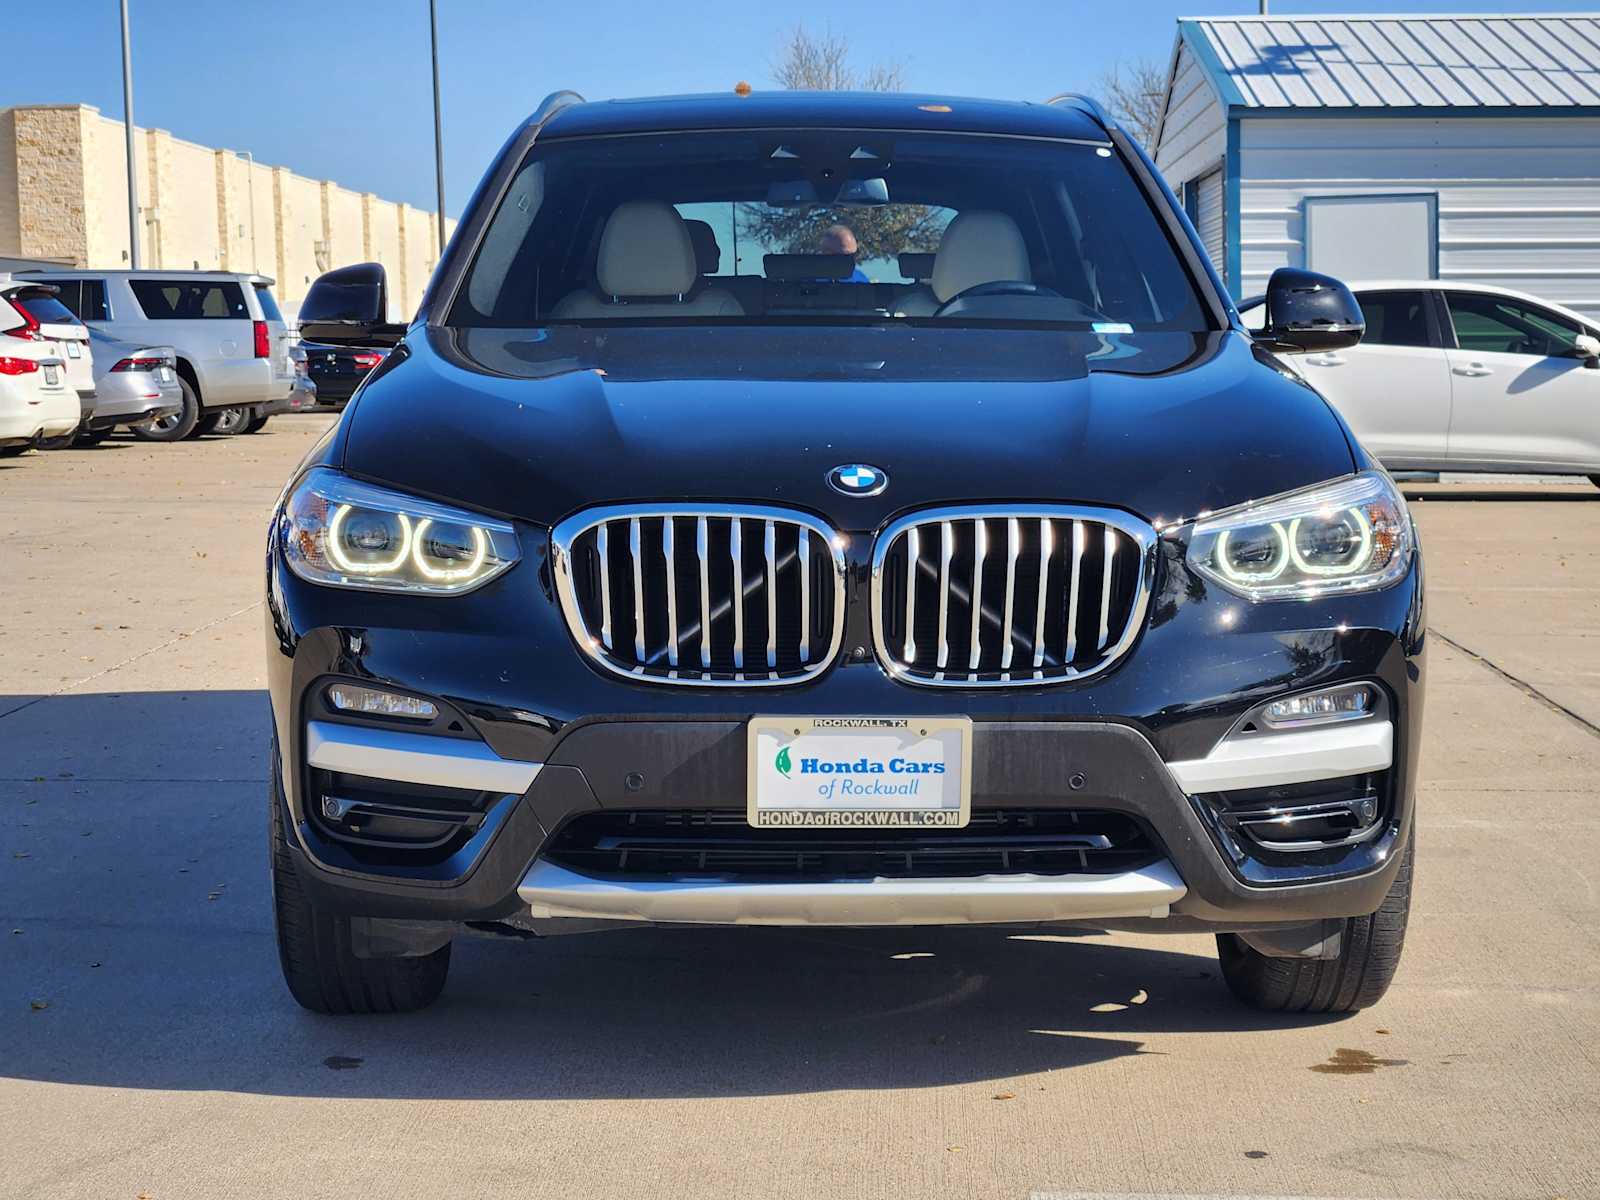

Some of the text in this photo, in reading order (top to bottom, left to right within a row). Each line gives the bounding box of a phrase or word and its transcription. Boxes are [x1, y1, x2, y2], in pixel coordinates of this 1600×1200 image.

[891, 719, 907, 727] TX
[800, 758, 946, 774] Honda Cars
[818, 778, 919, 799] of Rockwall
[759, 811, 959, 826] HONDAofROCKWALL.COM
